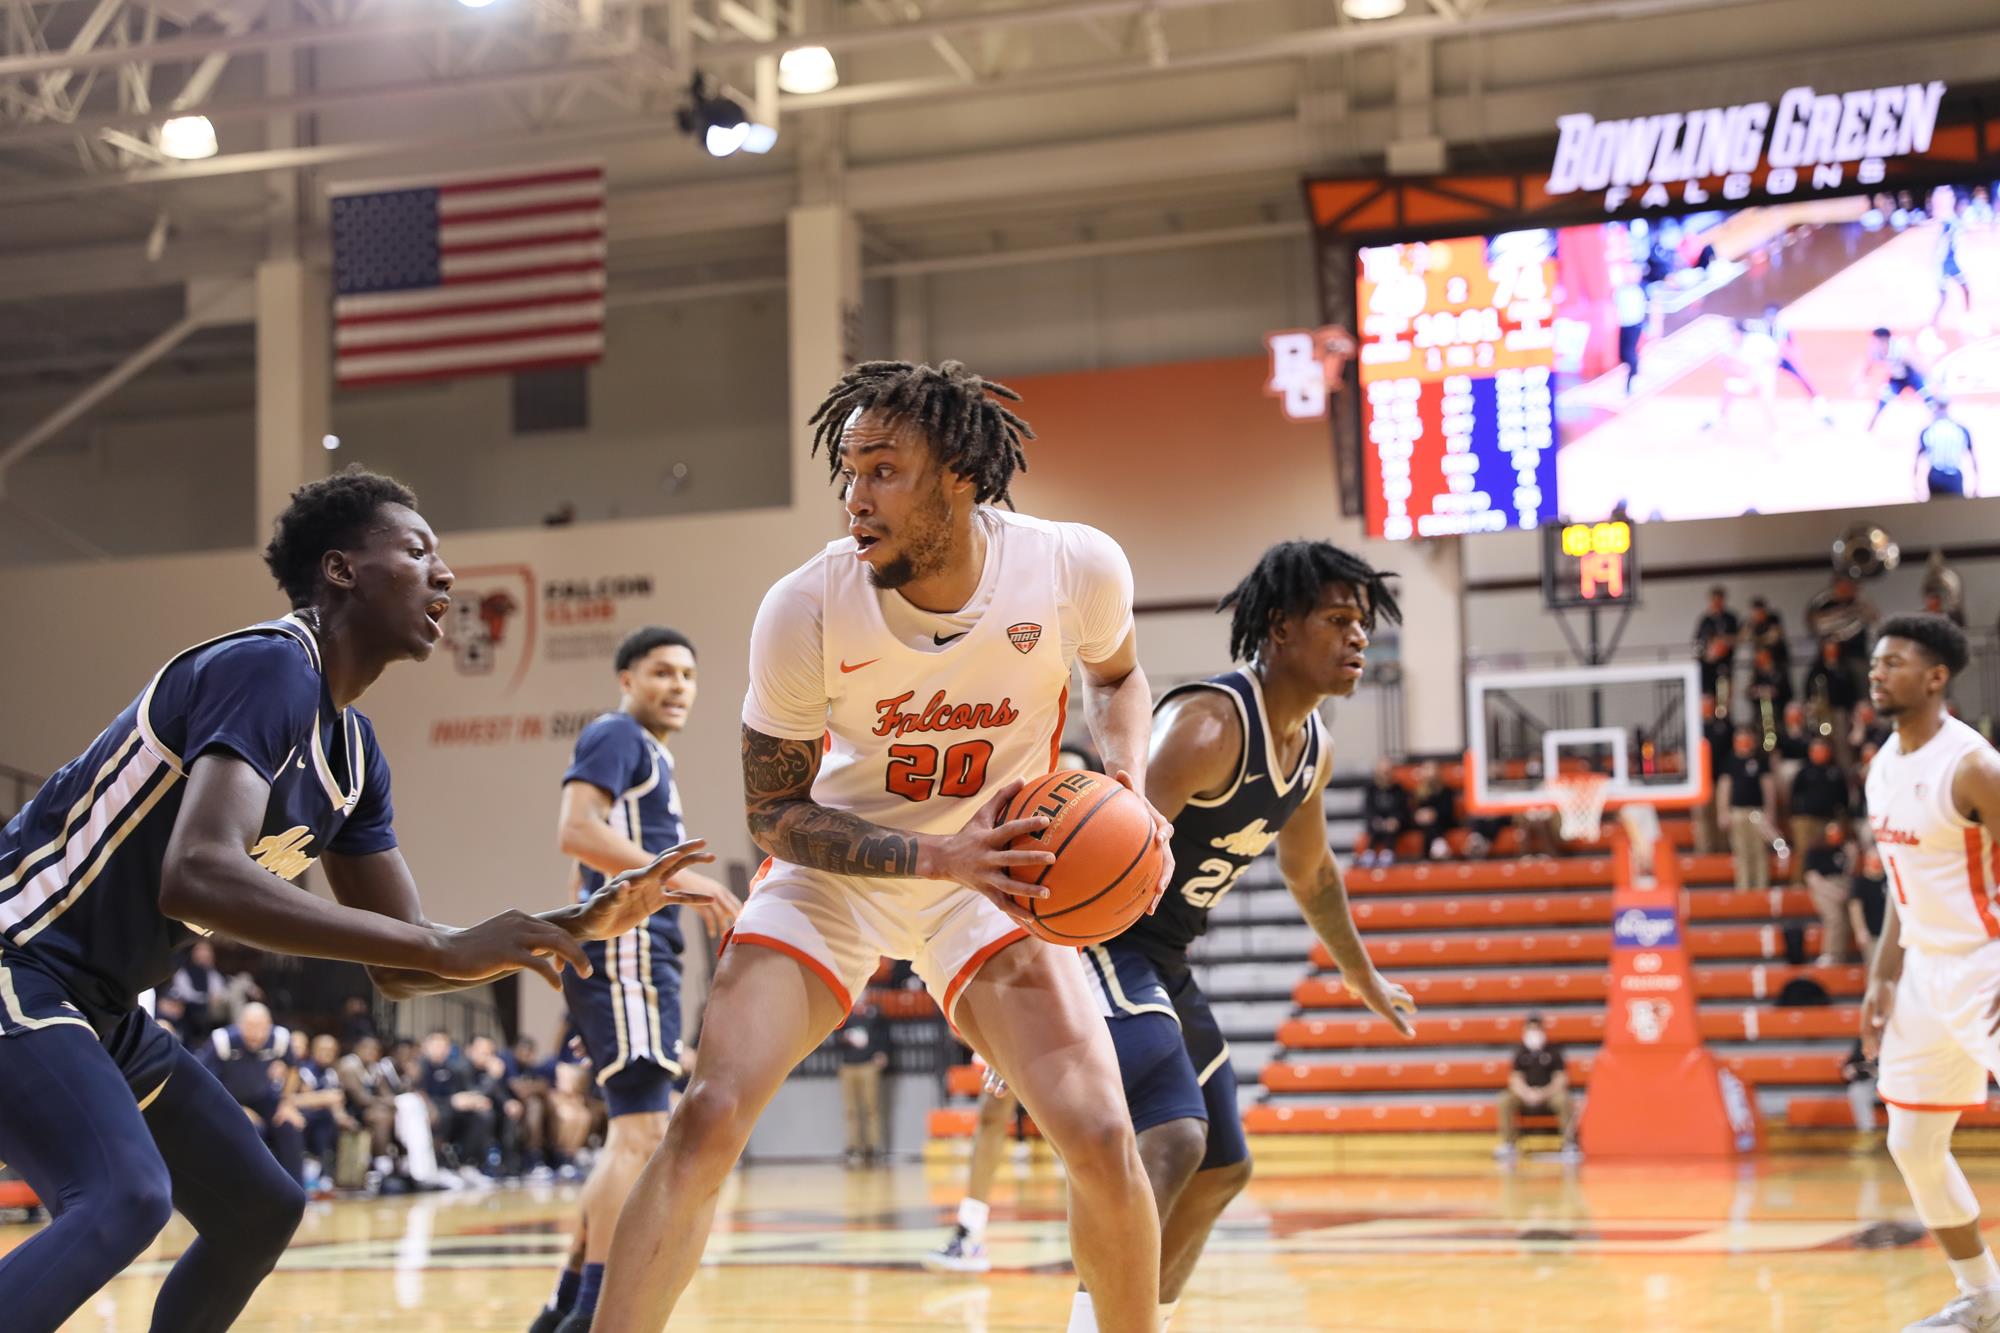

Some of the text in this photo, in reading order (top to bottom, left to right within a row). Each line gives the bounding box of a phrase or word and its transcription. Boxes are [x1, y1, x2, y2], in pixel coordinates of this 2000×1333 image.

[1545, 80, 1948, 195] BOWLING GREEN
[1603, 156, 1887, 213] FALCONS
[545, 576, 654, 600] FALCON
[1009, 631, 1041, 642] MAC
[431, 715, 511, 746] INVEST
[516, 713, 543, 743] IN
[872, 689, 1019, 738] Falcons
[885, 739, 994, 803] 20
